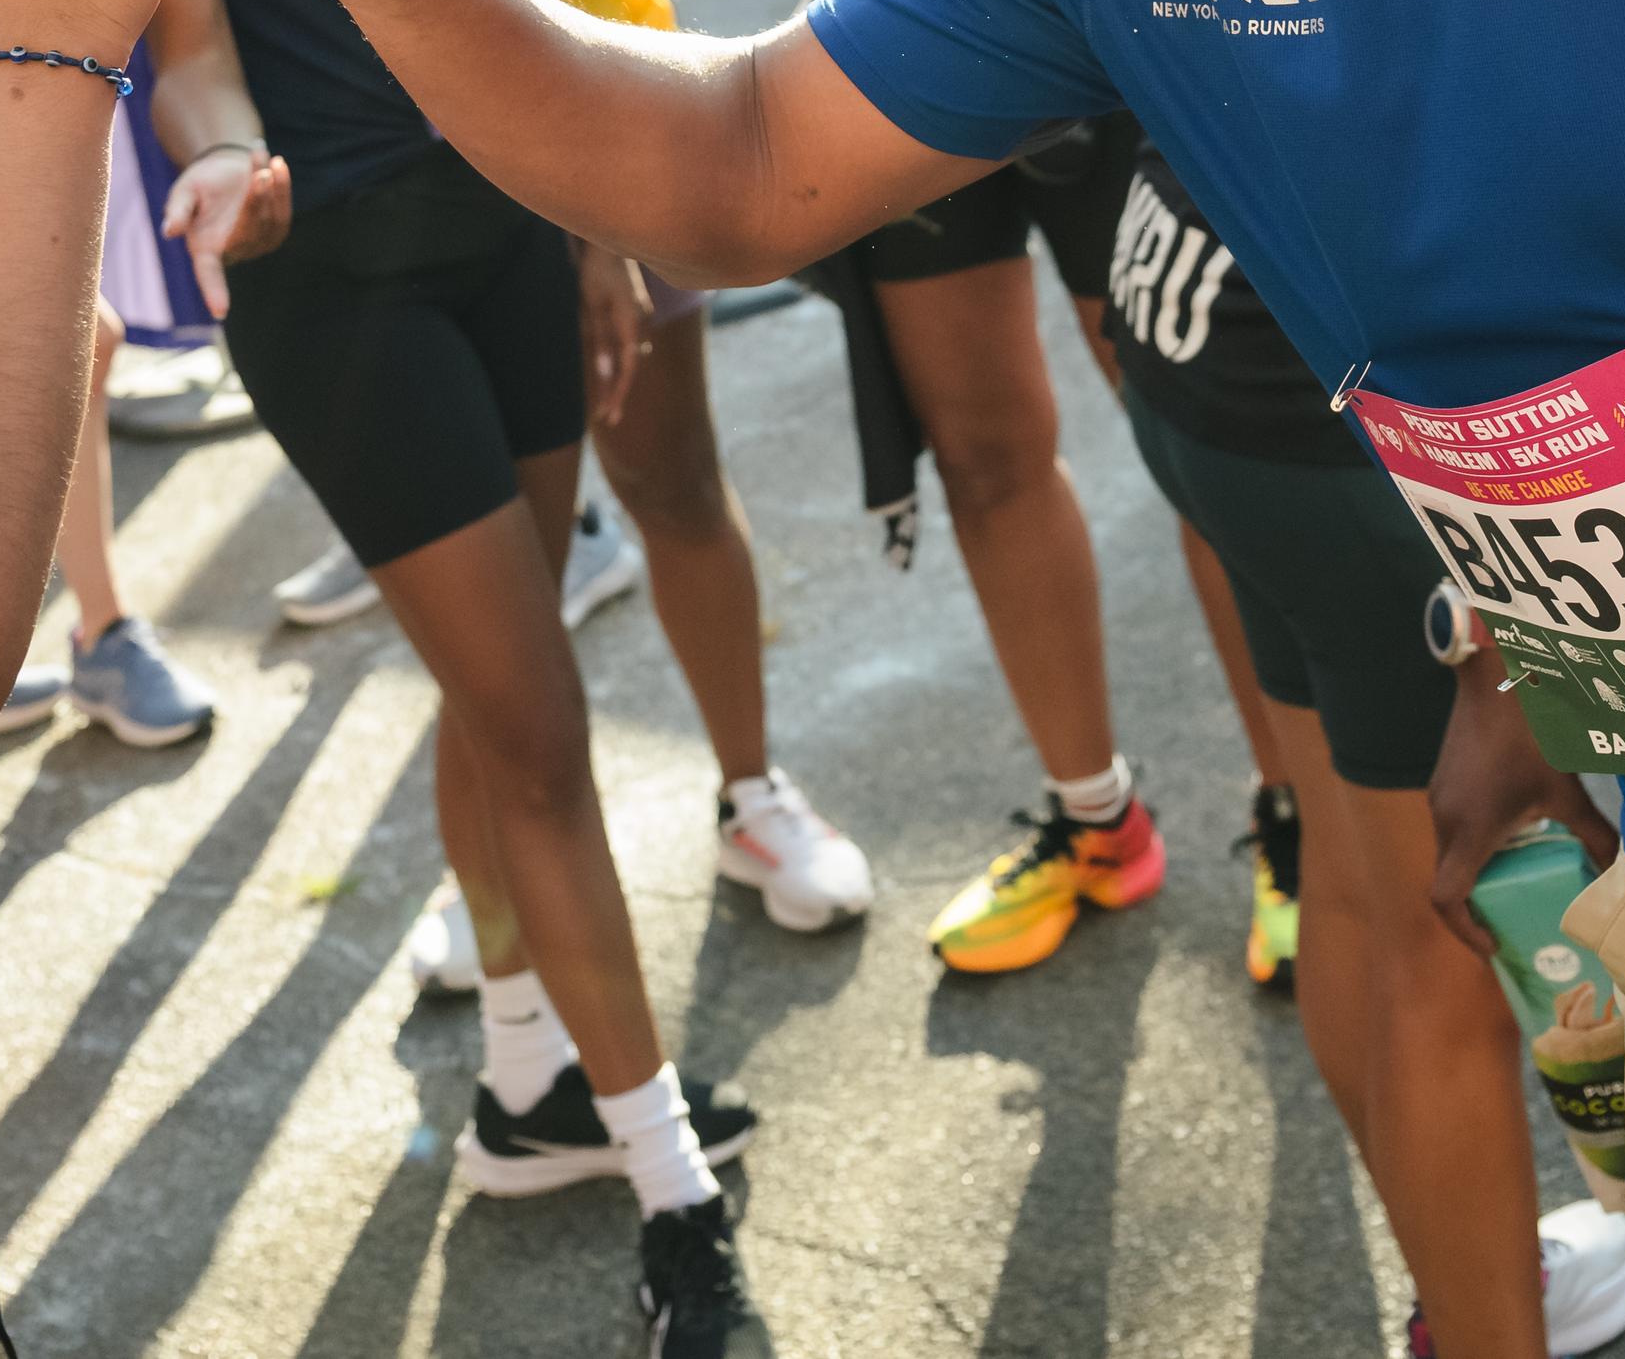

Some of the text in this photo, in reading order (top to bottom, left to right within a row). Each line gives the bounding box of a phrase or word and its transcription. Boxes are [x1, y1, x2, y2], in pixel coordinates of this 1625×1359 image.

[1152, 1, 1189, 19] NEW
[1191, 3, 1221, 21] YO
[1247, 17, 1326, 36] RUNNERS
[1400, 389, 1590, 442] PERCY SUTTON
[1420, 422, 1611, 471] HARLEM 5K RUN
[1463, 468, 1594, 502] BE THE CHANGE
[1582, 1082, 1624, 1099] PUR
